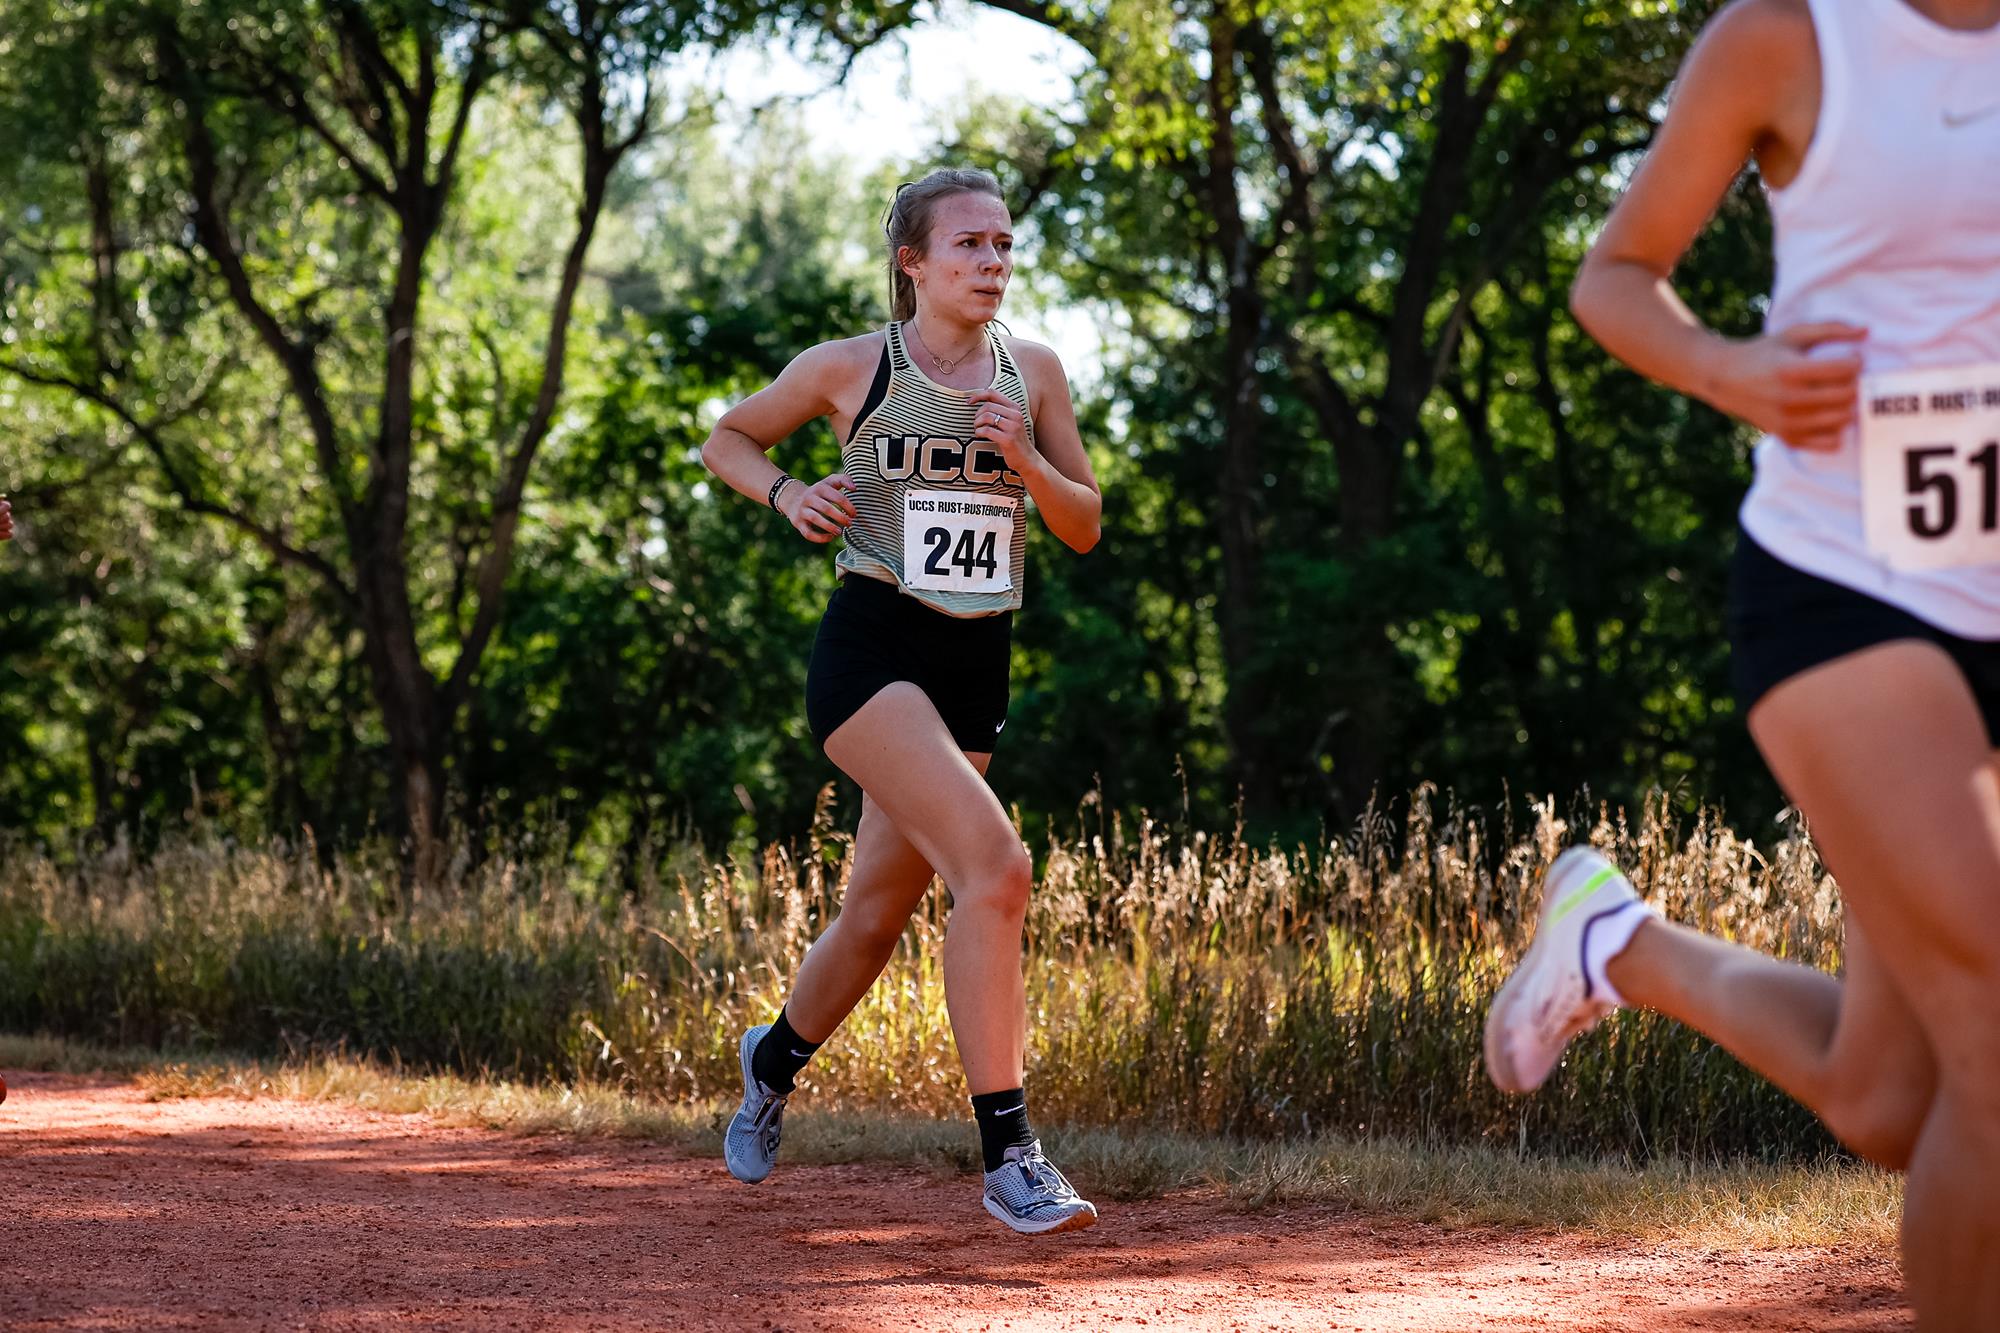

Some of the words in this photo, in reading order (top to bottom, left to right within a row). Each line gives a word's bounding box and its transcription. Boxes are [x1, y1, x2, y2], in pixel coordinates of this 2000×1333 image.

[909, 499, 935, 512] UCCS
[1904, 441, 2000, 541] 51
[923, 526, 997, 579] 244
